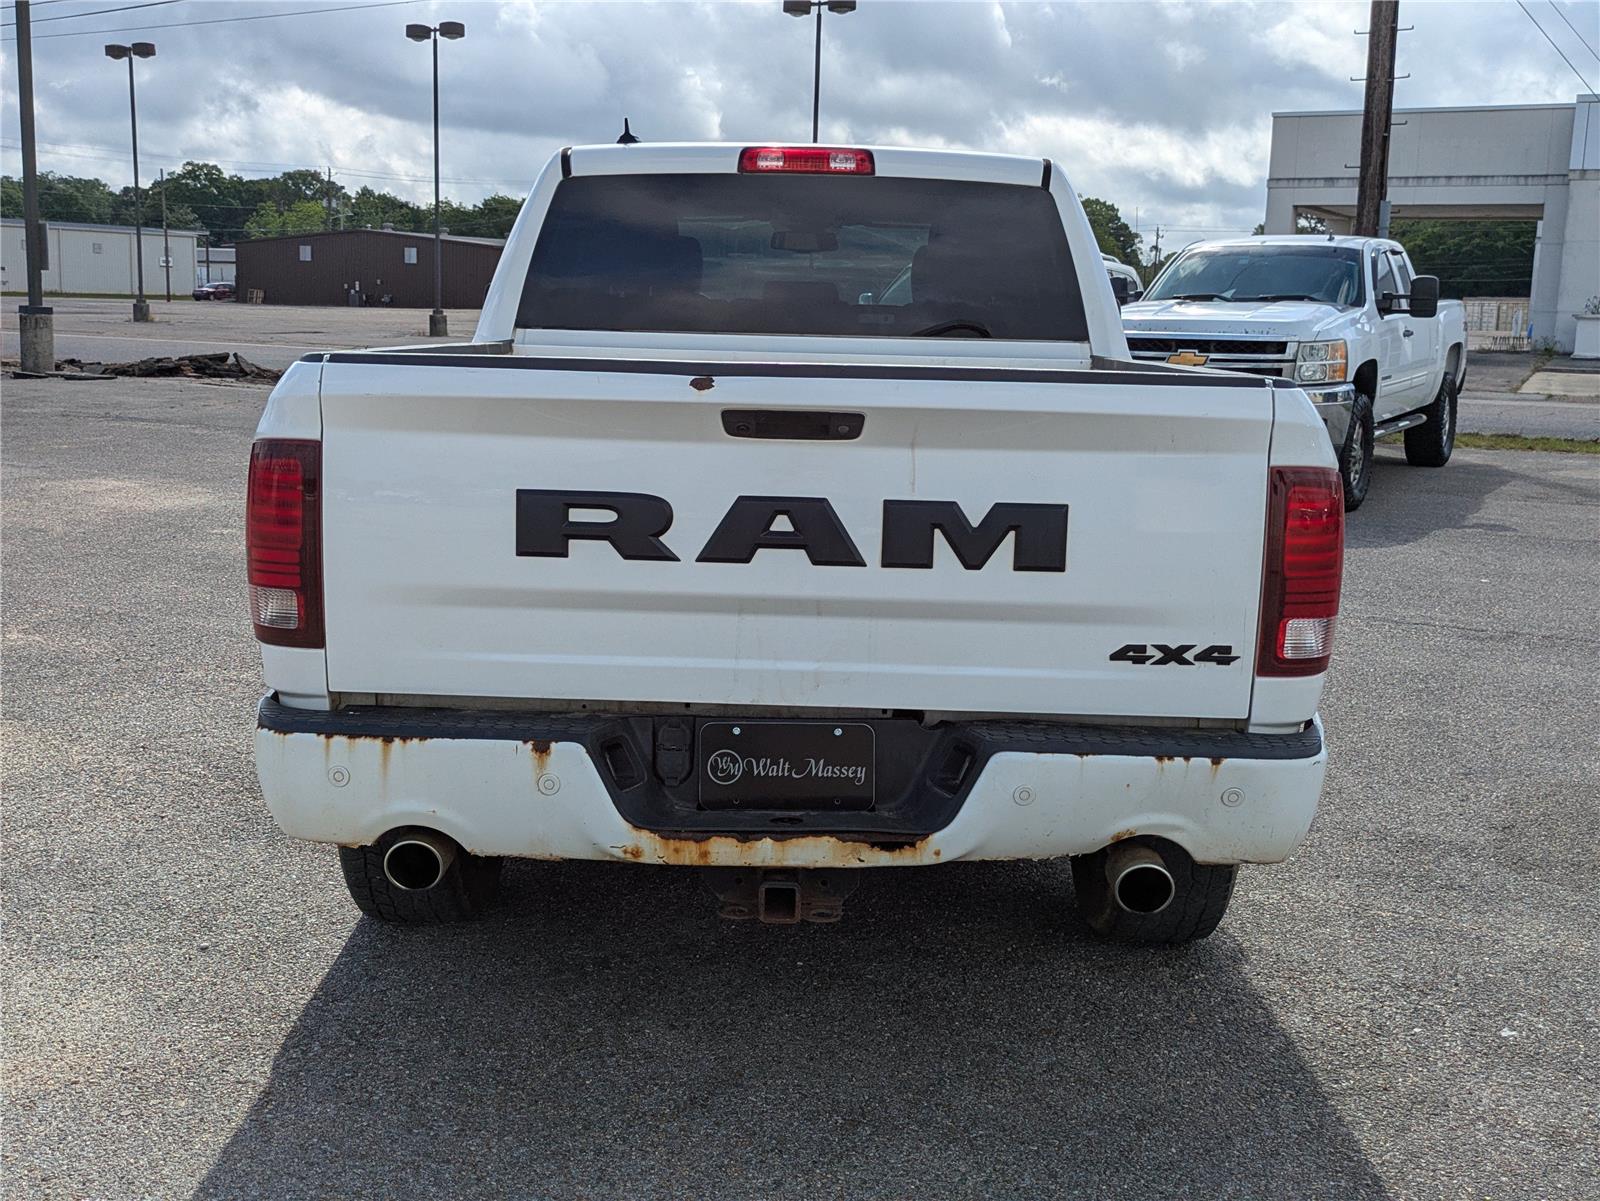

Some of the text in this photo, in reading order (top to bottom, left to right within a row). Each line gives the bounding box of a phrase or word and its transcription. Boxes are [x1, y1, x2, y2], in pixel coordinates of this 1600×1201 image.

[515, 488, 1069, 573] RAM
[1109, 644, 1241, 666] 4X4
[744, 757, 866, 785] Walt Massey
